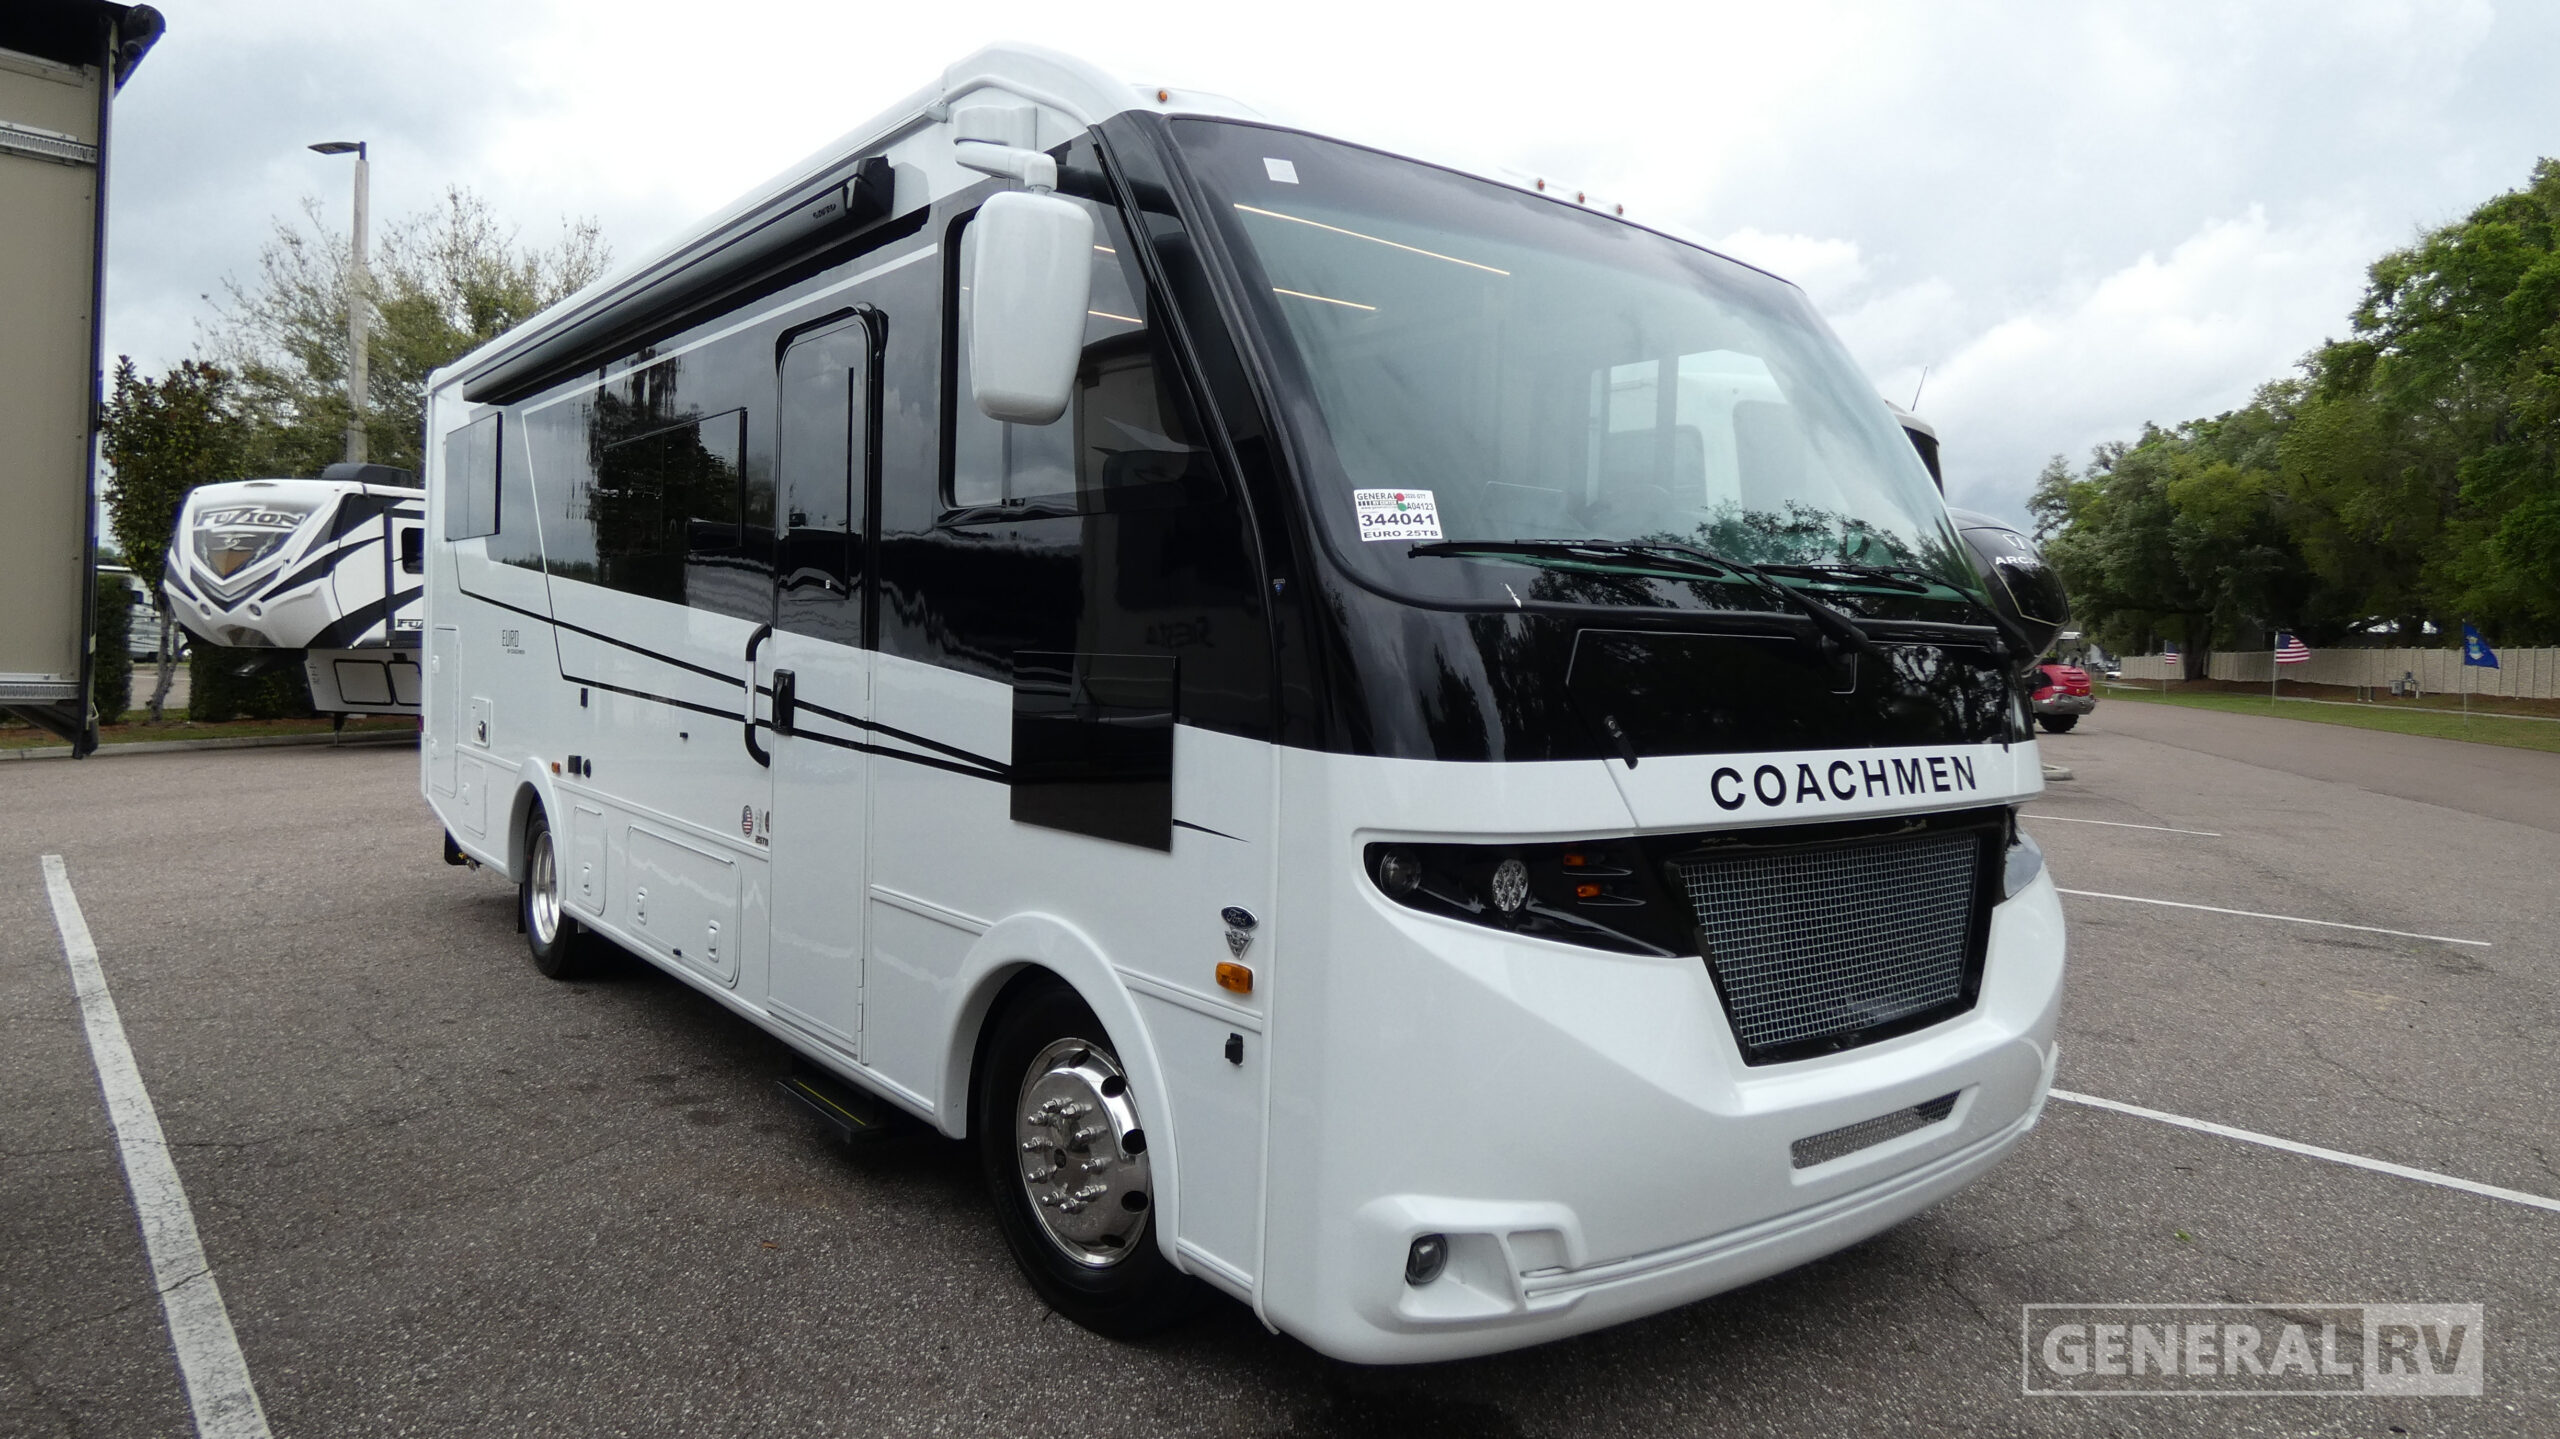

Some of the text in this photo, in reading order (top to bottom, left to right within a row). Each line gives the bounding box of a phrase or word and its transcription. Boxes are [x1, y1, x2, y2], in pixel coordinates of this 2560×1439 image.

[195, 507, 305, 529] FUZION
[1361, 513, 1435, 527] 344041
[1363, 529, 1438, 538] EURO 25TB
[1710, 755, 1977, 811] COACHMEN
